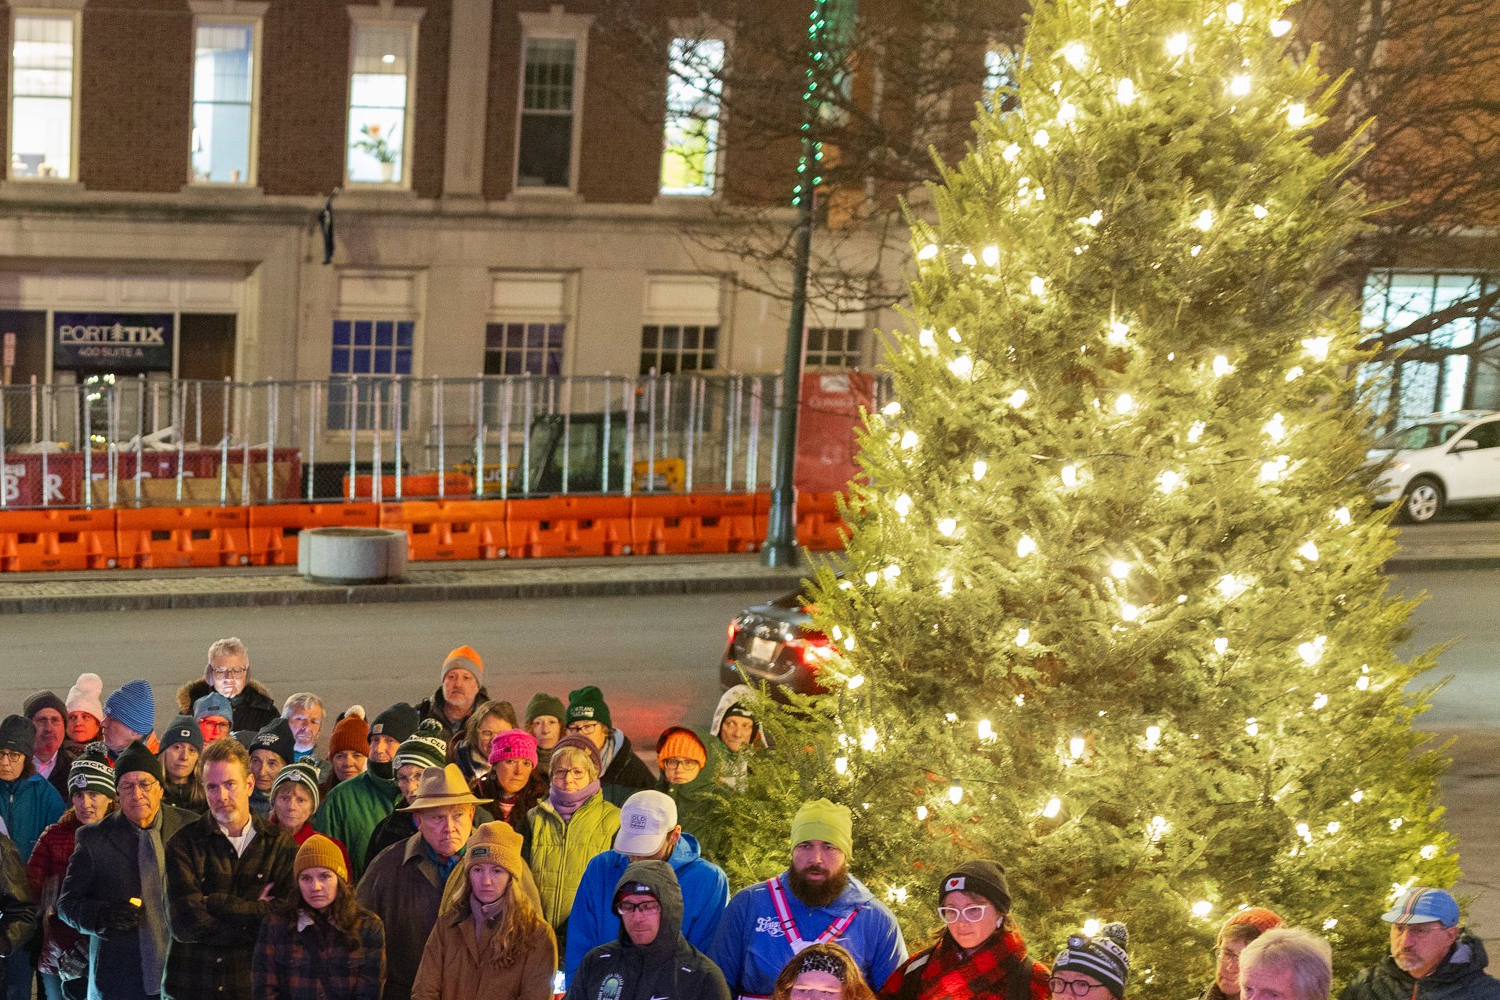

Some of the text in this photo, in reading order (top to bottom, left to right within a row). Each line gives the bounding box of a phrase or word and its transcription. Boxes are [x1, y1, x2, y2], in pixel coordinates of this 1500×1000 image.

[59, 325, 164, 344] PORT TIX
[102, 347, 132, 357] SUITE
[134, 347, 144, 357] A
[73, 761, 105, 771] TRACK
[1110, 945, 1129, 963] CLU
